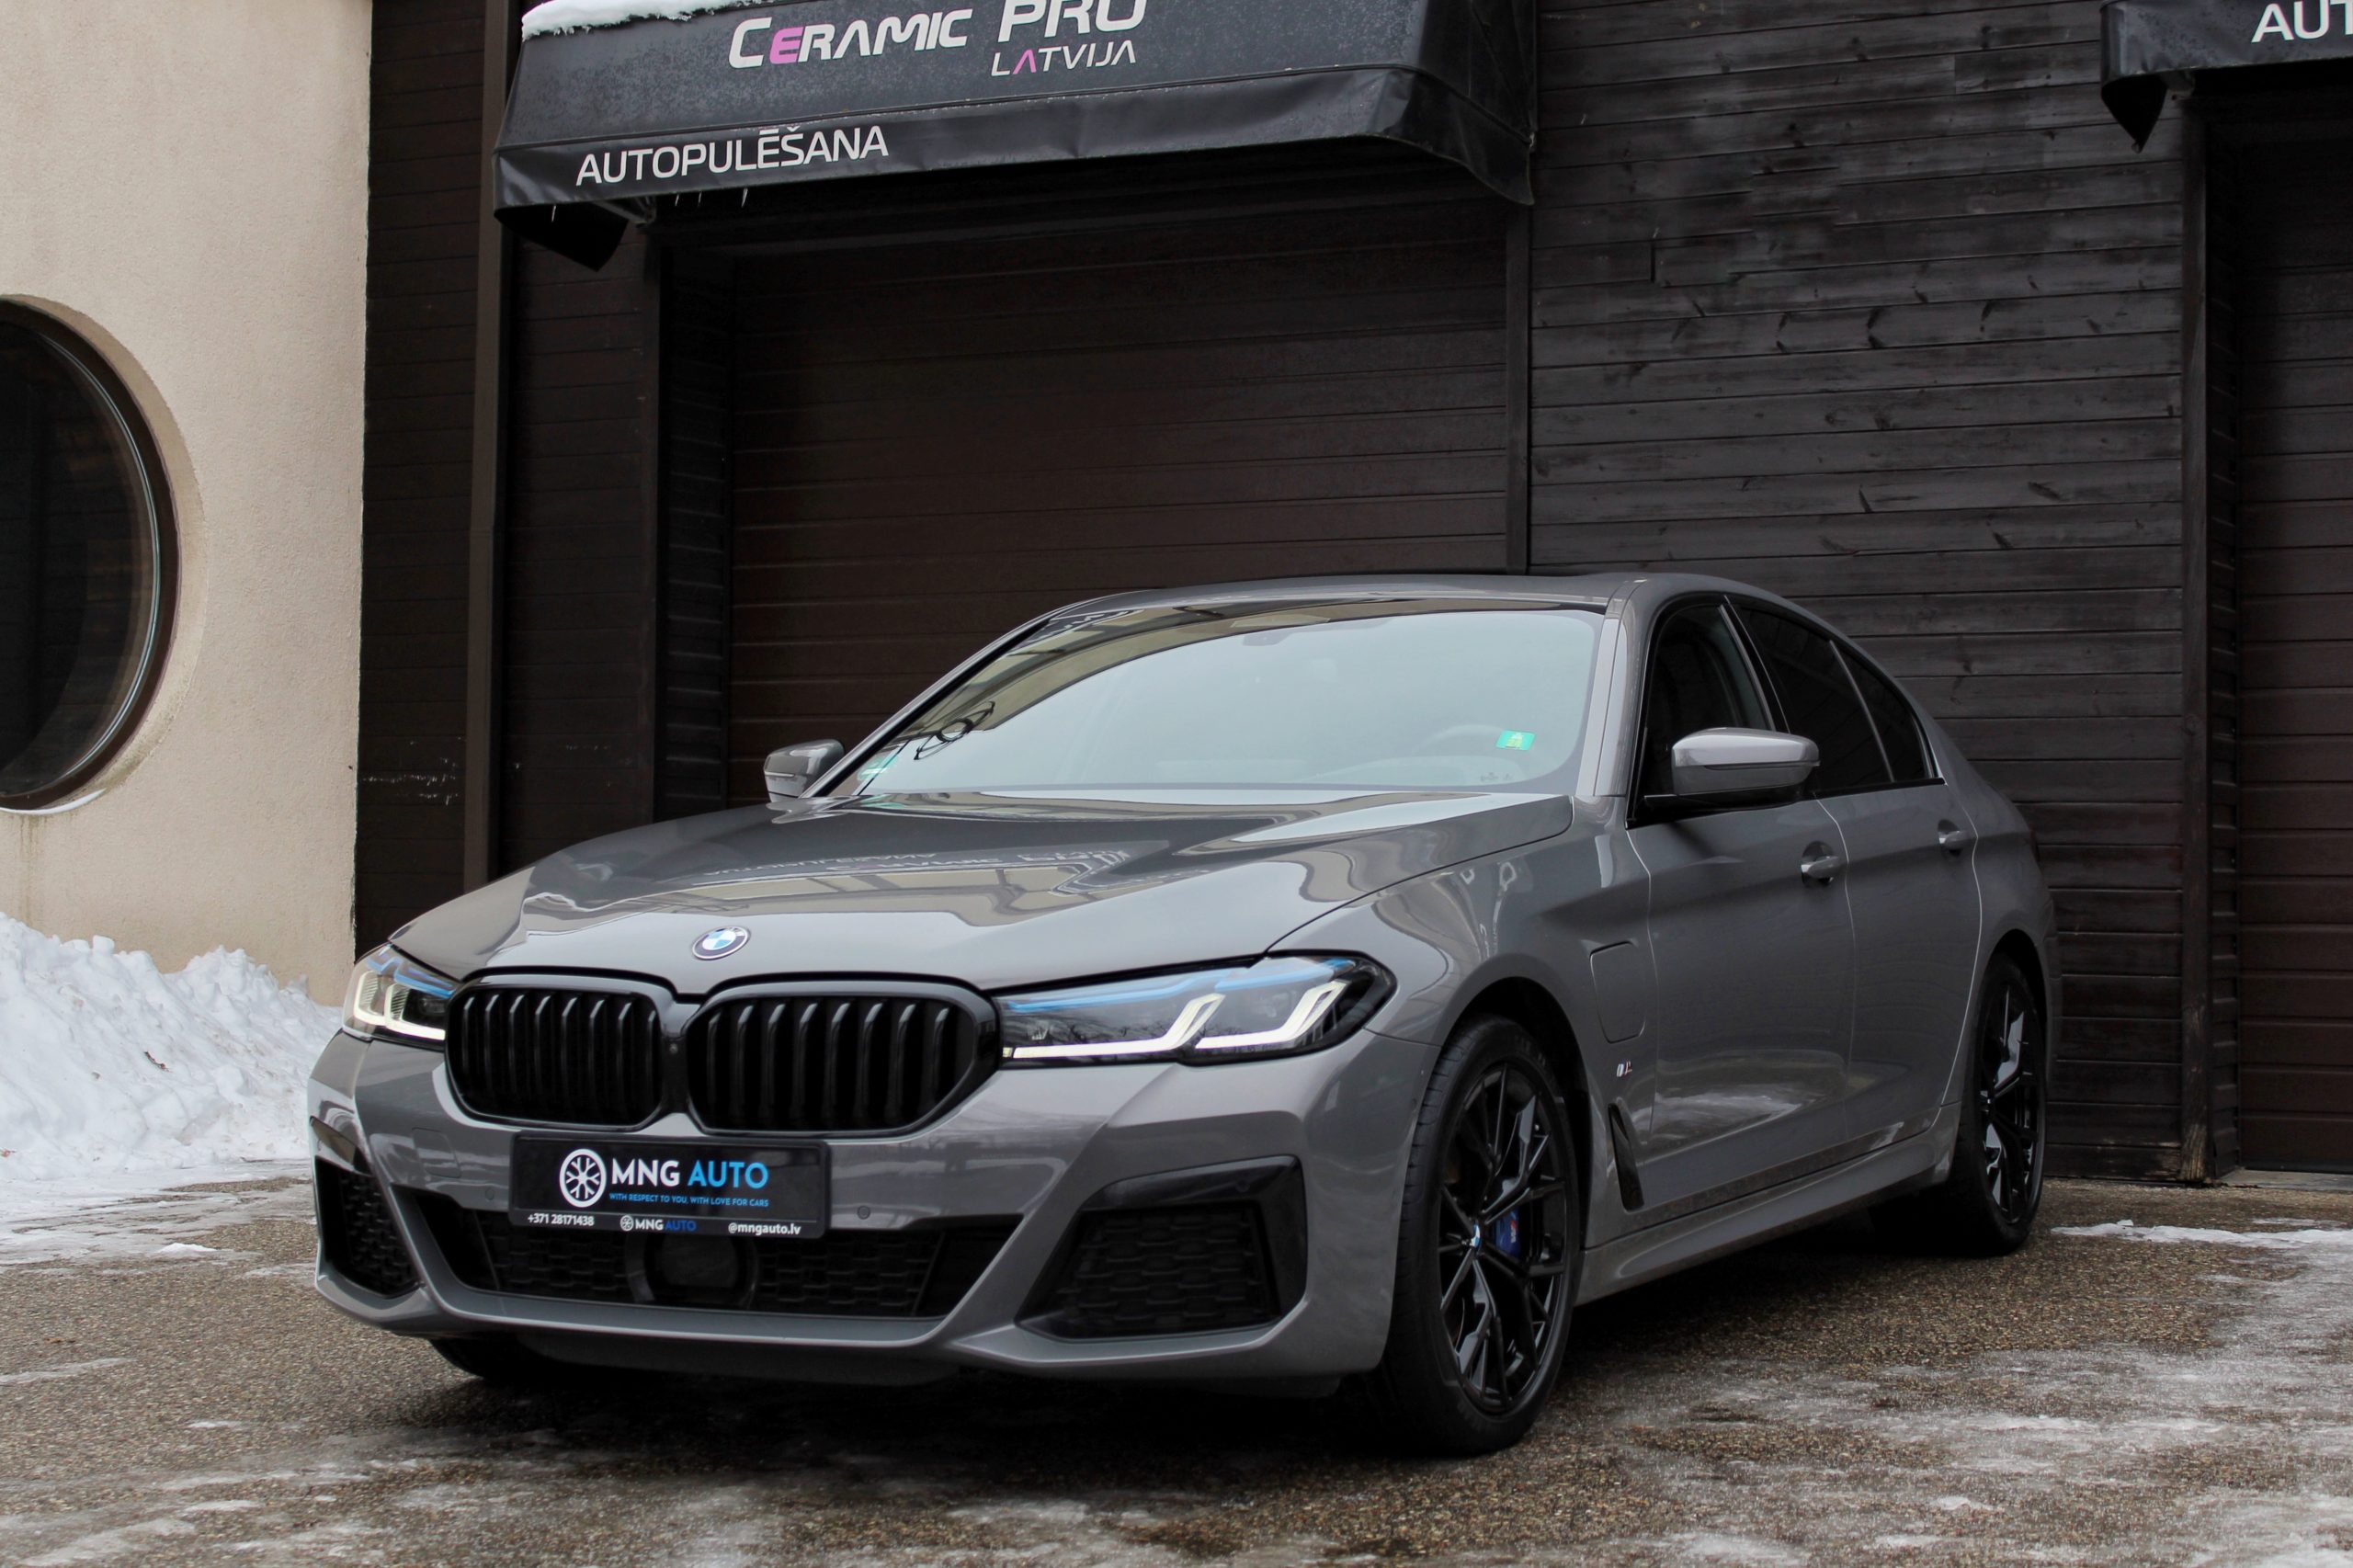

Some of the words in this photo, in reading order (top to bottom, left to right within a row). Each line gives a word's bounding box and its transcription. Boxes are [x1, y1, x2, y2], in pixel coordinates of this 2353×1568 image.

[729, 9, 972, 69] CERAMIC
[998, 0, 1147, 42] PRO
[991, 40, 1136, 76] LATVIJA
[575, 126, 889, 186] AUTOPULĒŠANA
[611, 1158, 680, 1187] MNG
[688, 1160, 769, 1189] AUTO
[609, 1193, 627, 1201] WITH
[629, 1193, 659, 1203] RESPECT
[660, 1195, 670, 1203] TO
[690, 1197, 709, 1205] WITH
[710, 1197, 731, 1206] LOVE
[733, 1198, 747, 1207] FOR
[749, 1199, 769, 1207] CARS
[528, 1212, 550, 1224] +371
[551, 1213, 595, 1227] 28171438
[635, 1218, 664, 1231] MNG
[665, 1220, 696, 1233] AUTO
[728, 1221, 801, 1236] @mngauto.lv
